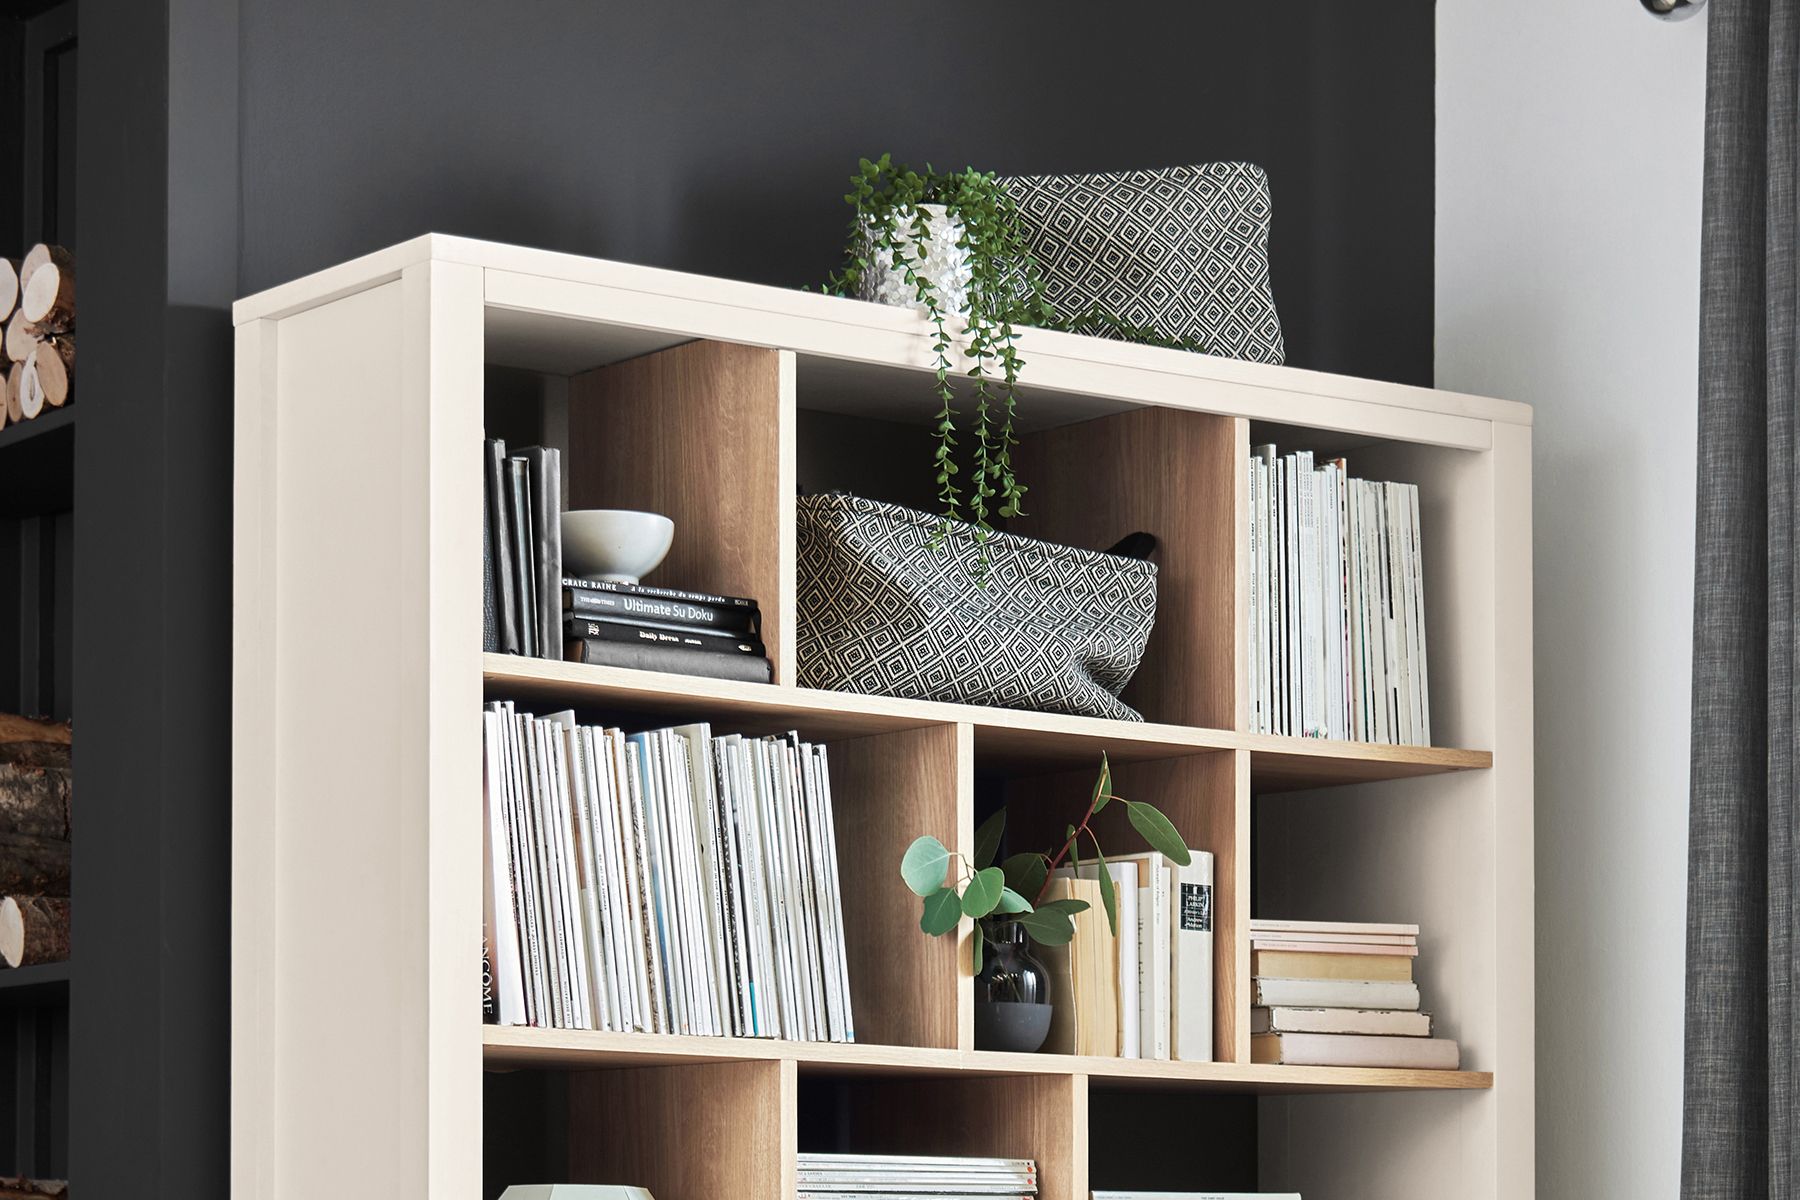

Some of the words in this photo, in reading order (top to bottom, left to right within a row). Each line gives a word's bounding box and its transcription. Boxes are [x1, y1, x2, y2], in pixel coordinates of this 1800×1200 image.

[562, 578, 588, 588] CRAIG
[591, 581, 617, 591] RAINE
[623, 598, 672, 616] Ultimate
[672, 604, 686, 618] Su
[688, 606, 714, 622] Doku
[639, 630, 658, 641] Daily
